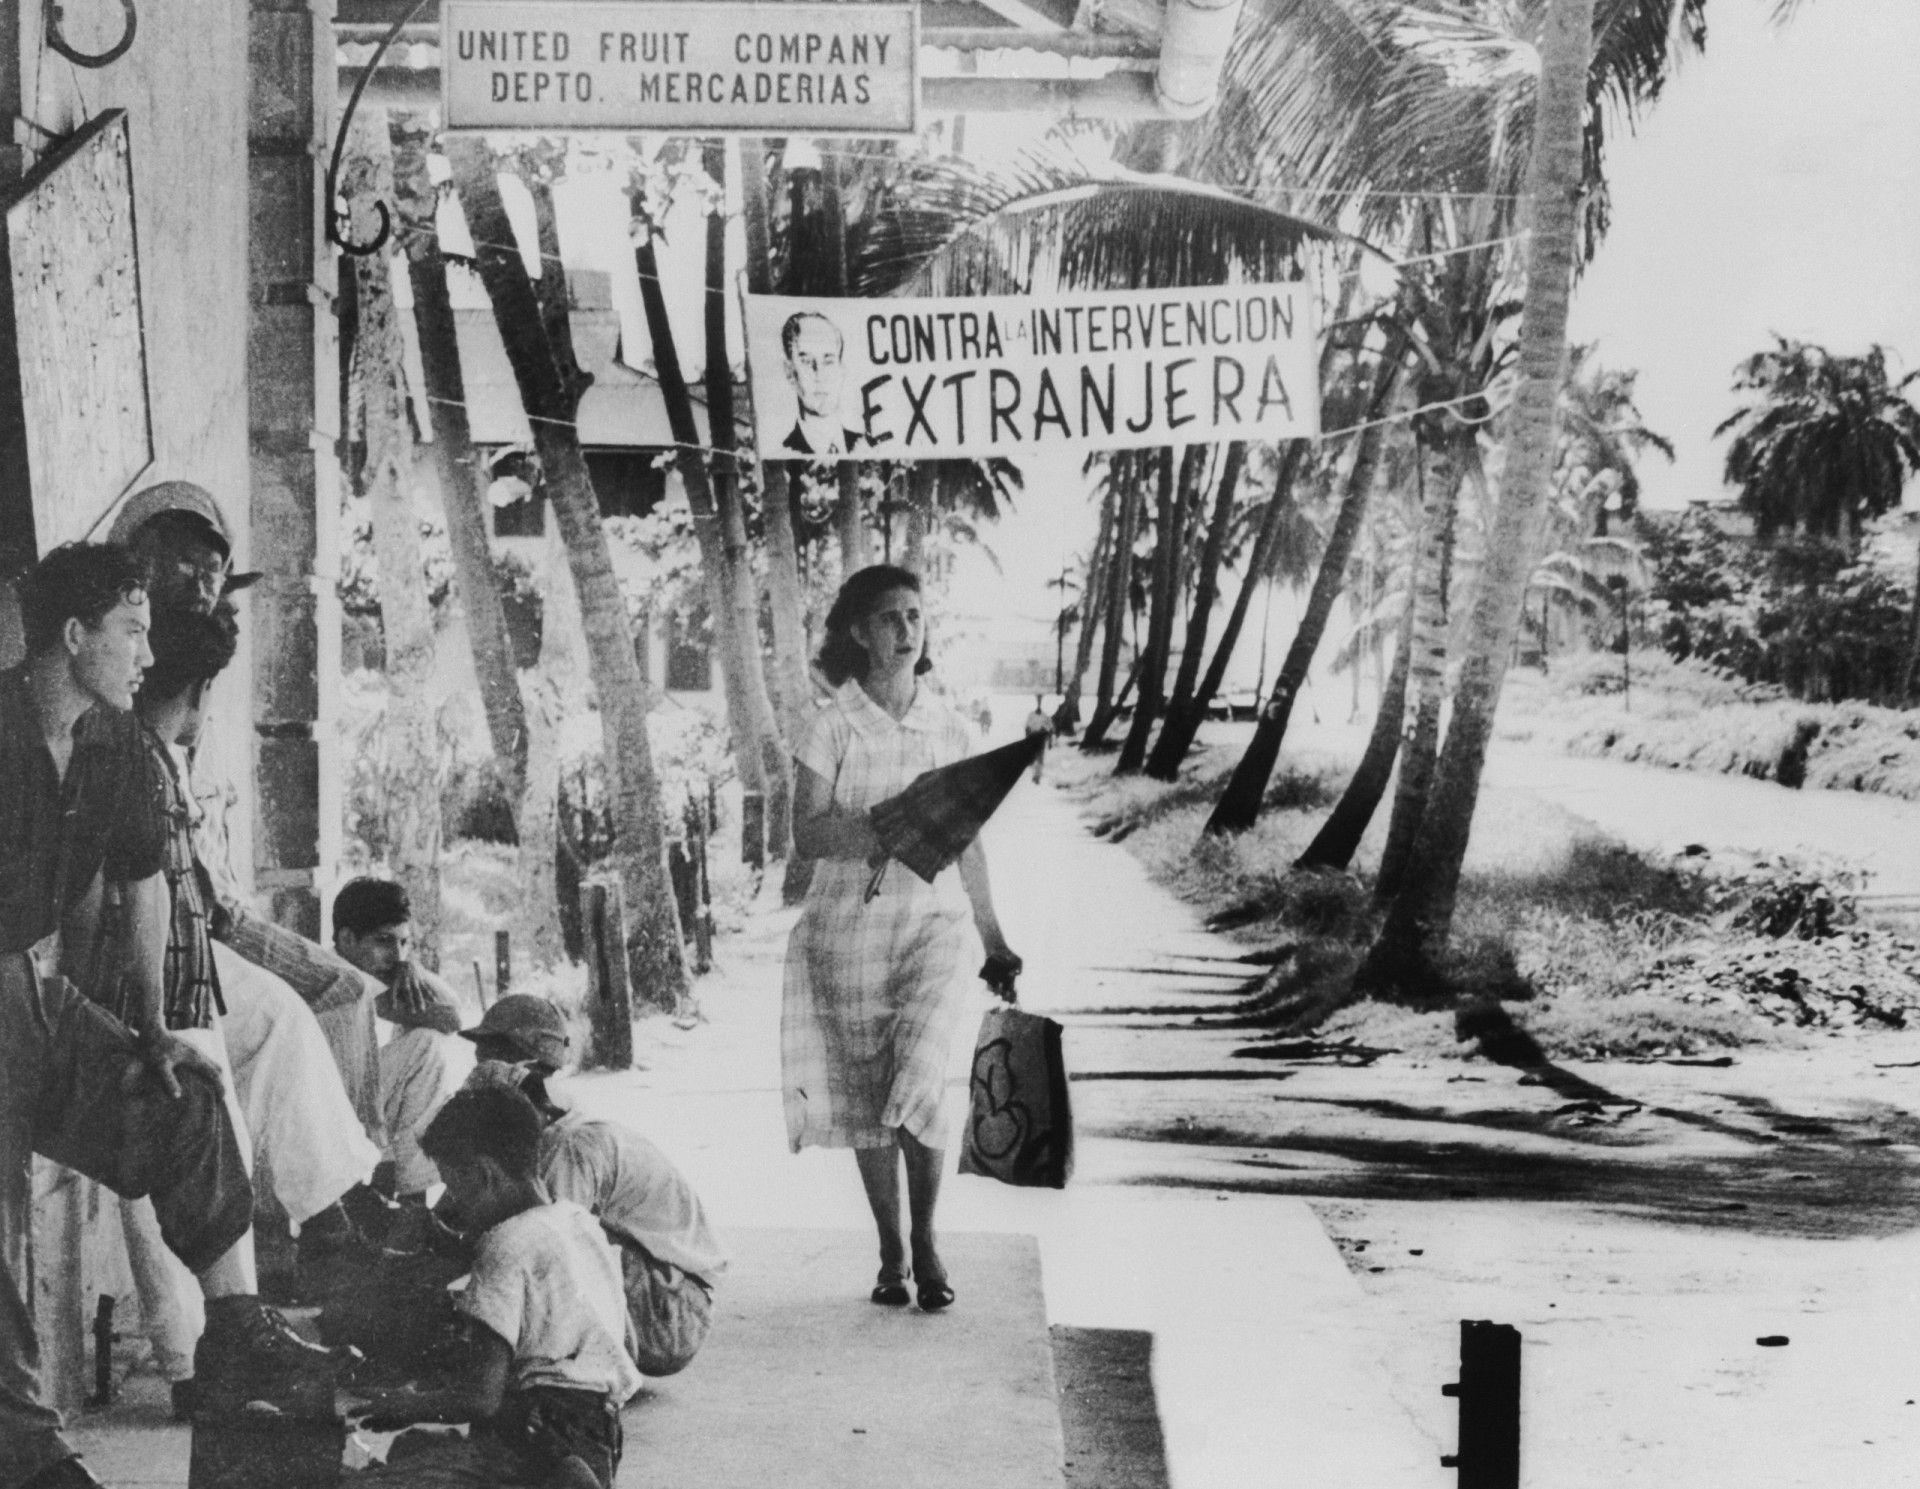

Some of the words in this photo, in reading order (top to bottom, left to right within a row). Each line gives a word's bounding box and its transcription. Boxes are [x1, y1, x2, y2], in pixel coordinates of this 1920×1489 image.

[458, 30, 570, 62] UNITED
[599, 32, 690, 64] FRUIT
[734, 33, 892, 66] COMPANY
[492, 71, 605, 102] DEPTO.
[640, 72, 871, 104] MERCADERIAS
[866, 311, 1004, 365] CONTRA
[1004, 319, 1028, 342] LA
[1031, 294, 1294, 356] INTERVENCION
[860, 354, 1295, 448] EXTRANJERA
